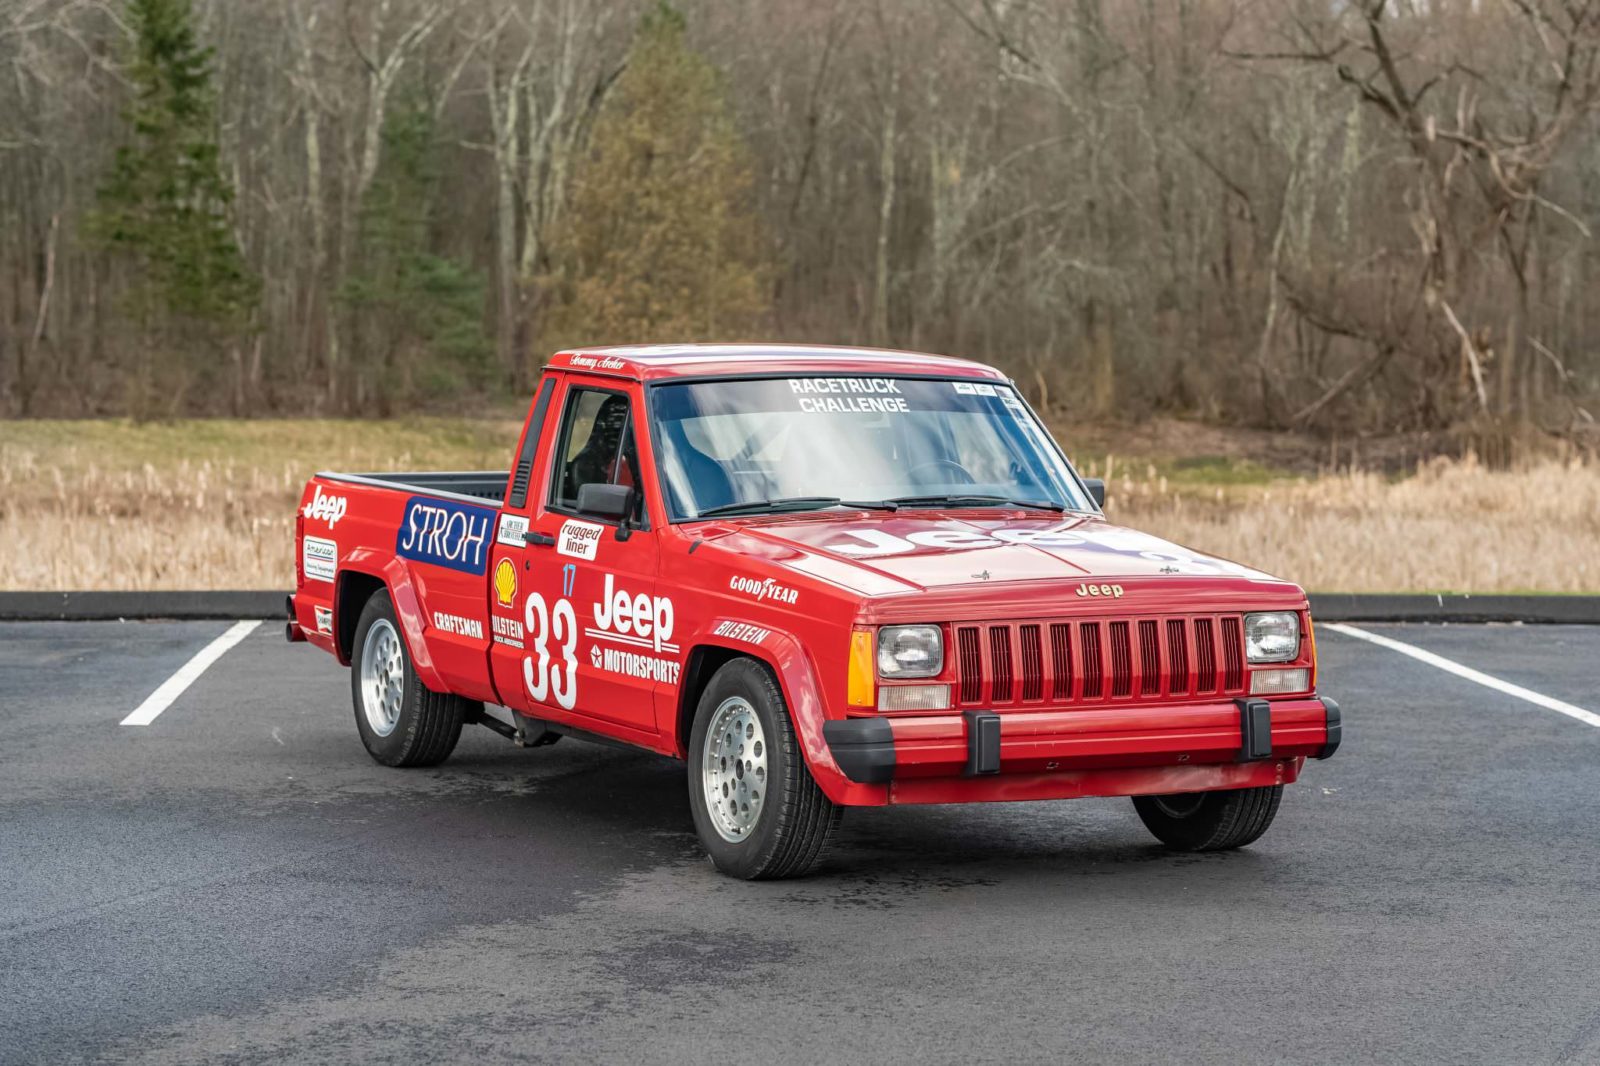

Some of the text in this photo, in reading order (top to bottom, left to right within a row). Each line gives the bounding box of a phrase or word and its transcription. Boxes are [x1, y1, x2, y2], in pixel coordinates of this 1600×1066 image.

[788, 378, 902, 394] RACETRUCK
[799, 397, 910, 413] CHALLENGE
[300, 485, 348, 529] Jeep
[402, 504, 488, 565] STROH
[562, 523, 600, 542] rugged
[565, 538, 590, 554] liner
[563, 563, 576, 597] 17
[1075, 582, 1125, 598] Jeep
[433, 611, 484, 639] CRAFTSMAN
[593, 573, 674, 653] Jeep
[713, 620, 771, 645] BILSTEIN
[523, 592, 579, 711] 33
[603, 648, 681, 685] MOTORSPORTS
